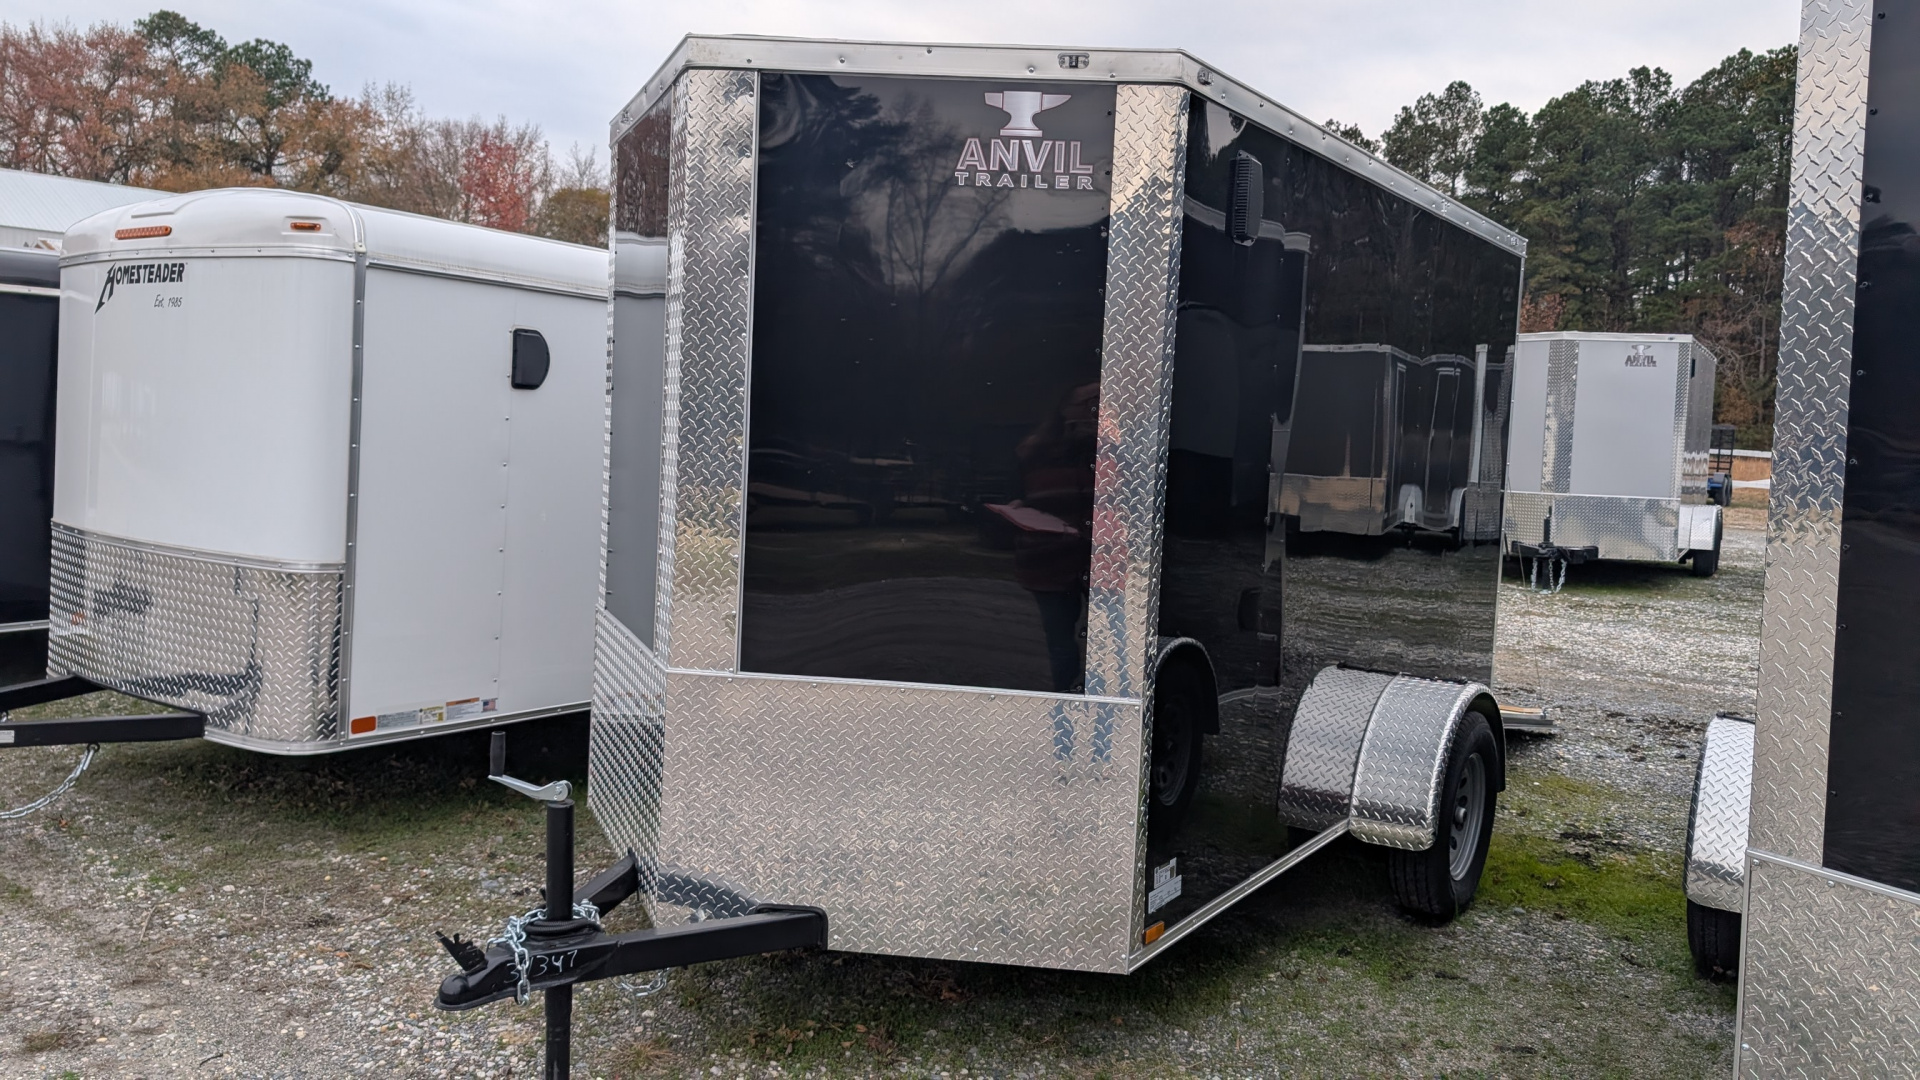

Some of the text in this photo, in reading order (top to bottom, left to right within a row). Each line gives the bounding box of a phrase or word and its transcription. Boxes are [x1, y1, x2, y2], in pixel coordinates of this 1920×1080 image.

[956, 137, 1094, 174] ANVIL
[955, 171, 1094, 190] TRAILER
[94, 262, 185, 314] HOMESTEADER
[167, 297, 183, 308] 1985
